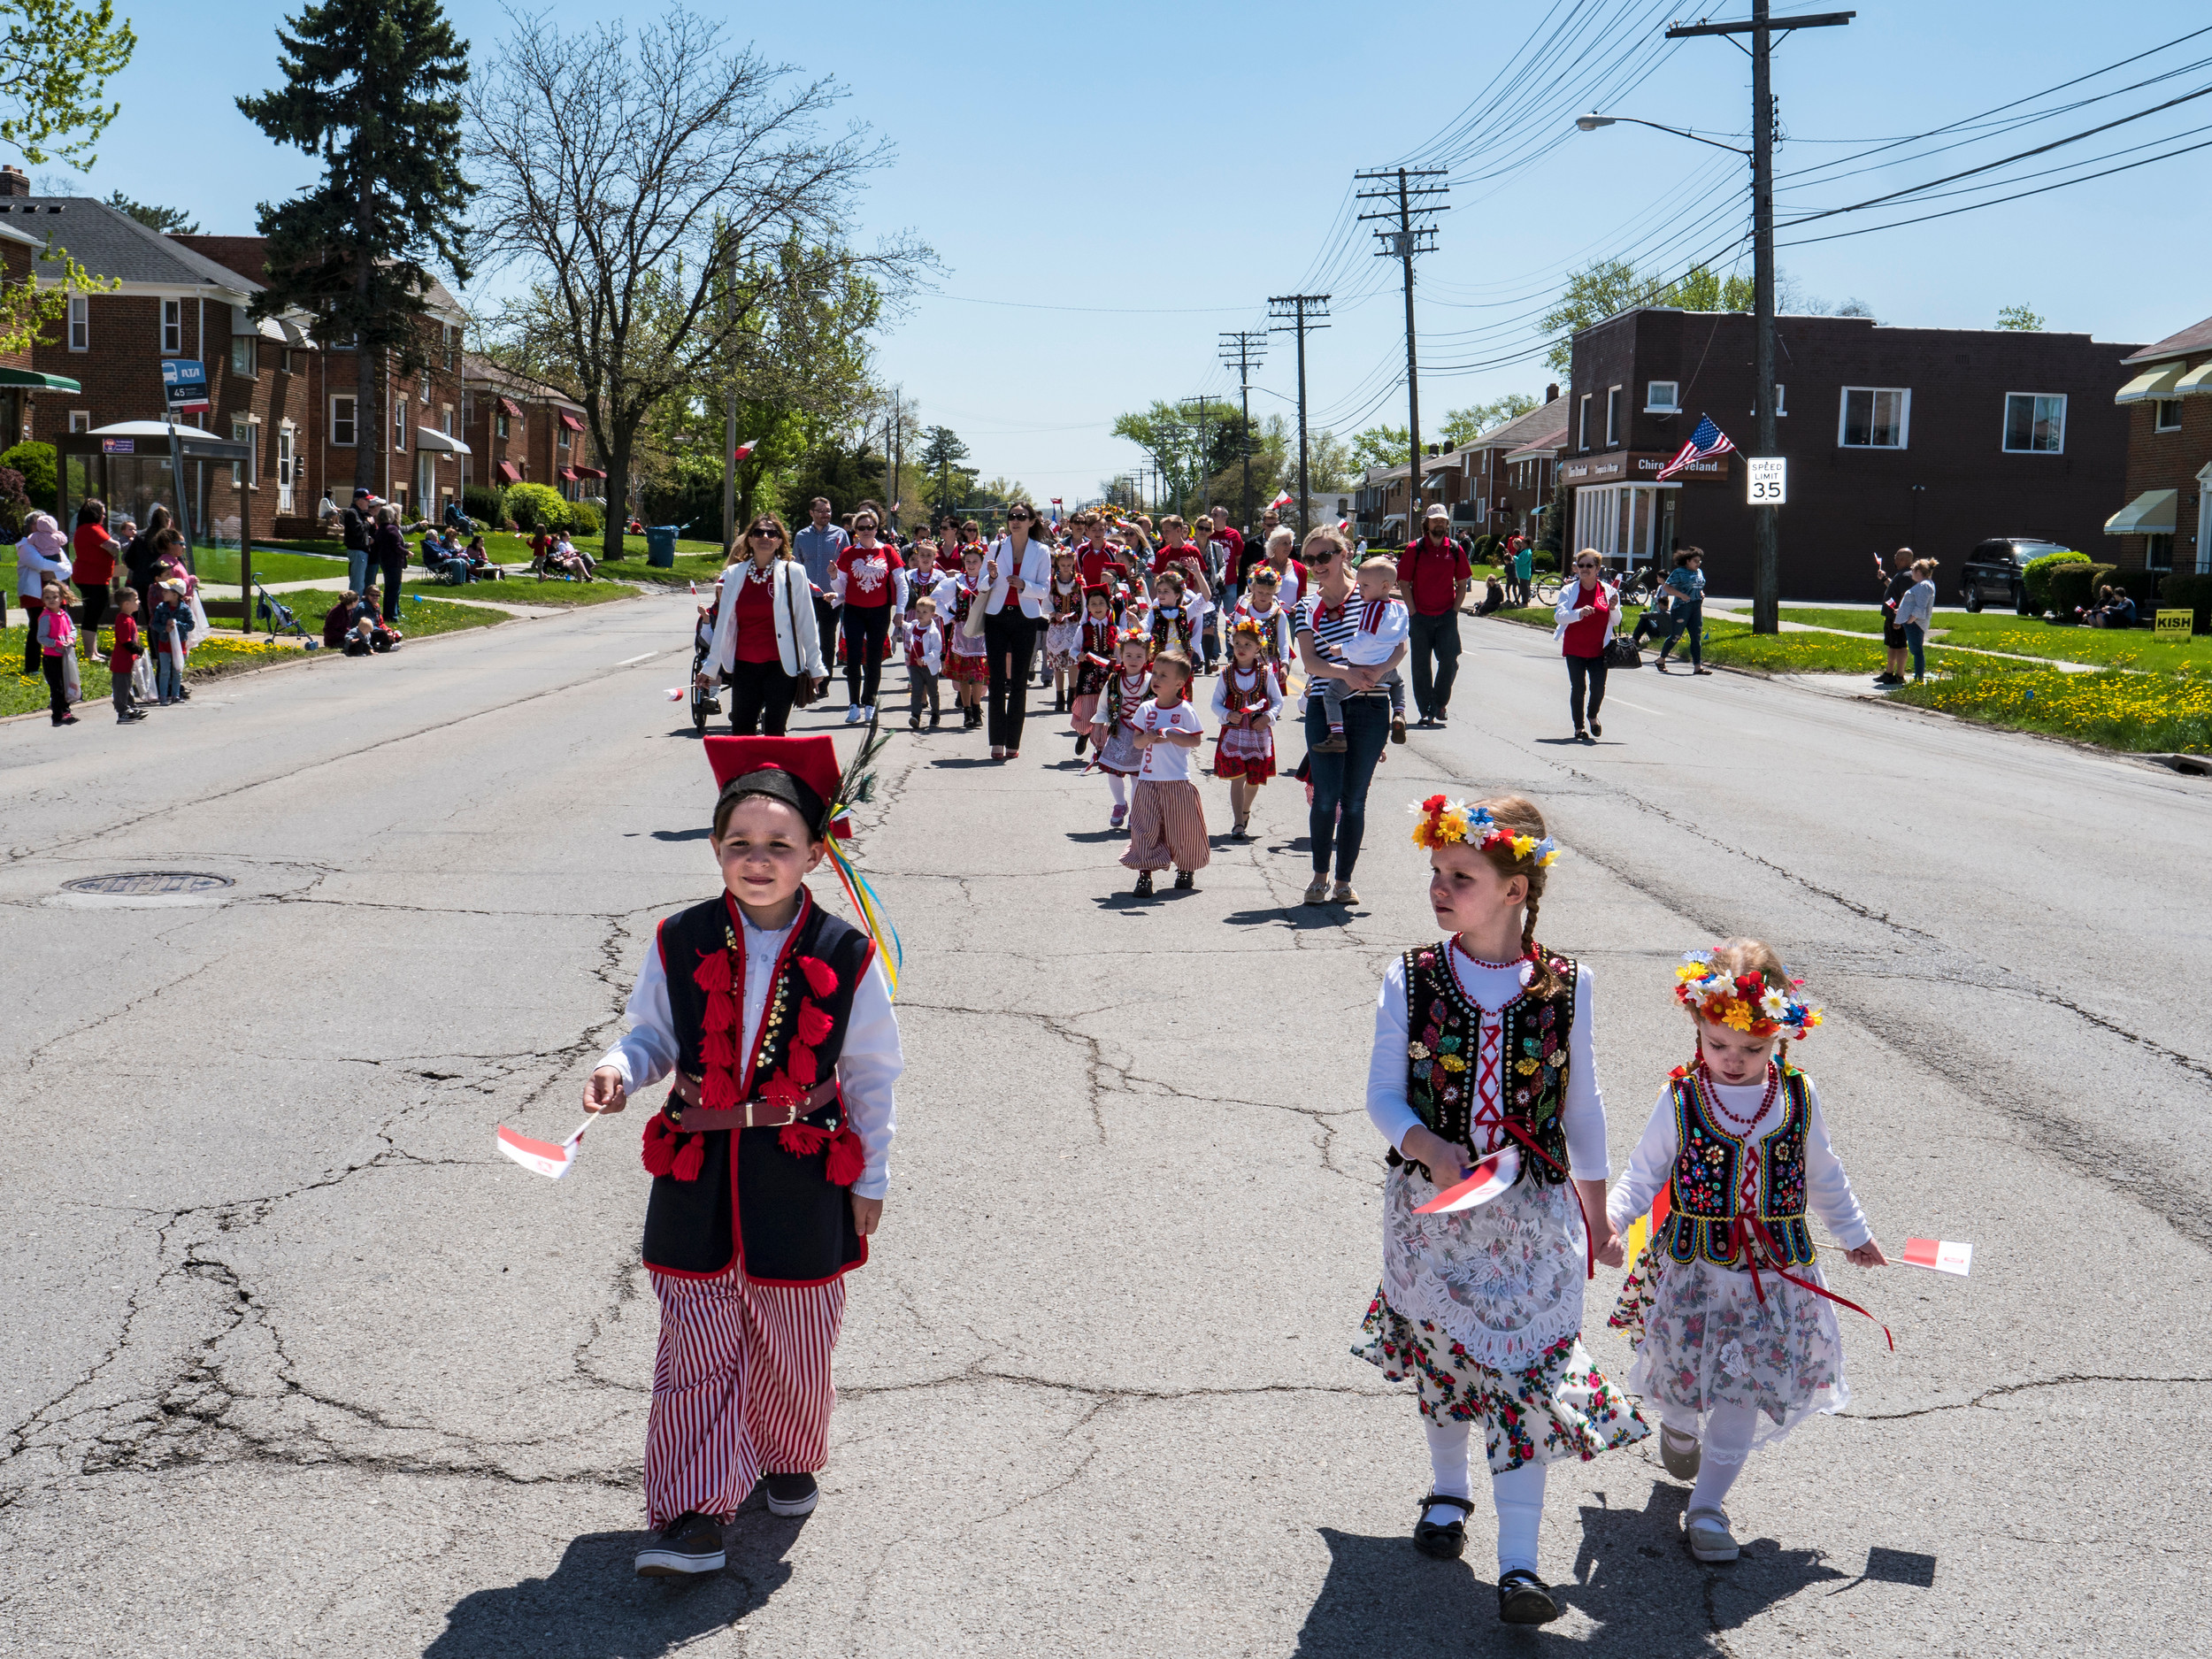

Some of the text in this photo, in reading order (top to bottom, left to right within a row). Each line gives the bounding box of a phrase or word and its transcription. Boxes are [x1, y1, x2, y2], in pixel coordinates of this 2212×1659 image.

[181, 368, 200, 378] RTA
[1639, 459, 1718, 472] Chiro veland
[1753, 482, 1780, 497] 35
[2157, 618, 2191, 628] KISH
[1142, 710, 1157, 773] POLND
